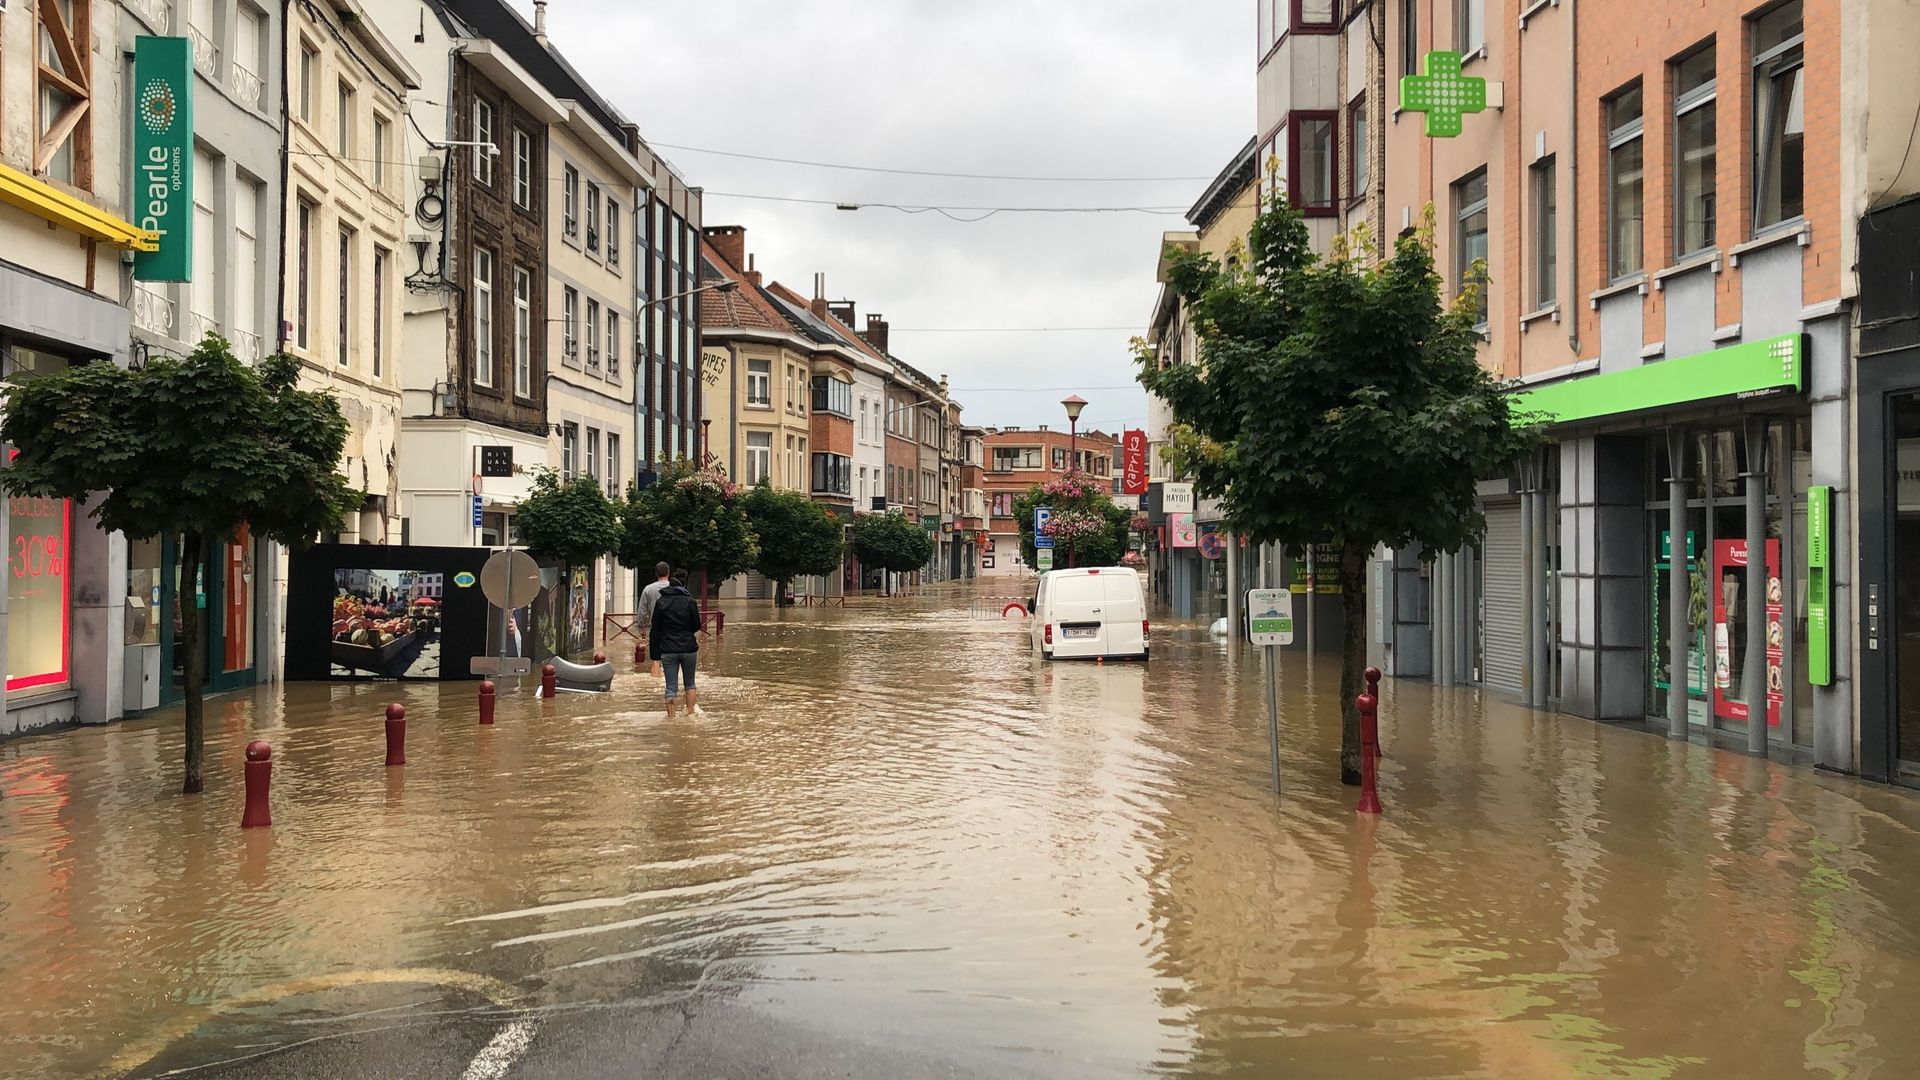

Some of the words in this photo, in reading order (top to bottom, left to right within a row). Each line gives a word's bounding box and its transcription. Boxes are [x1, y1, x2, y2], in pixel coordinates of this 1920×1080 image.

[142, 146, 168, 235] Pearle
[171, 146, 182, 191] opticiens
[702, 352, 727, 375] PIPES
